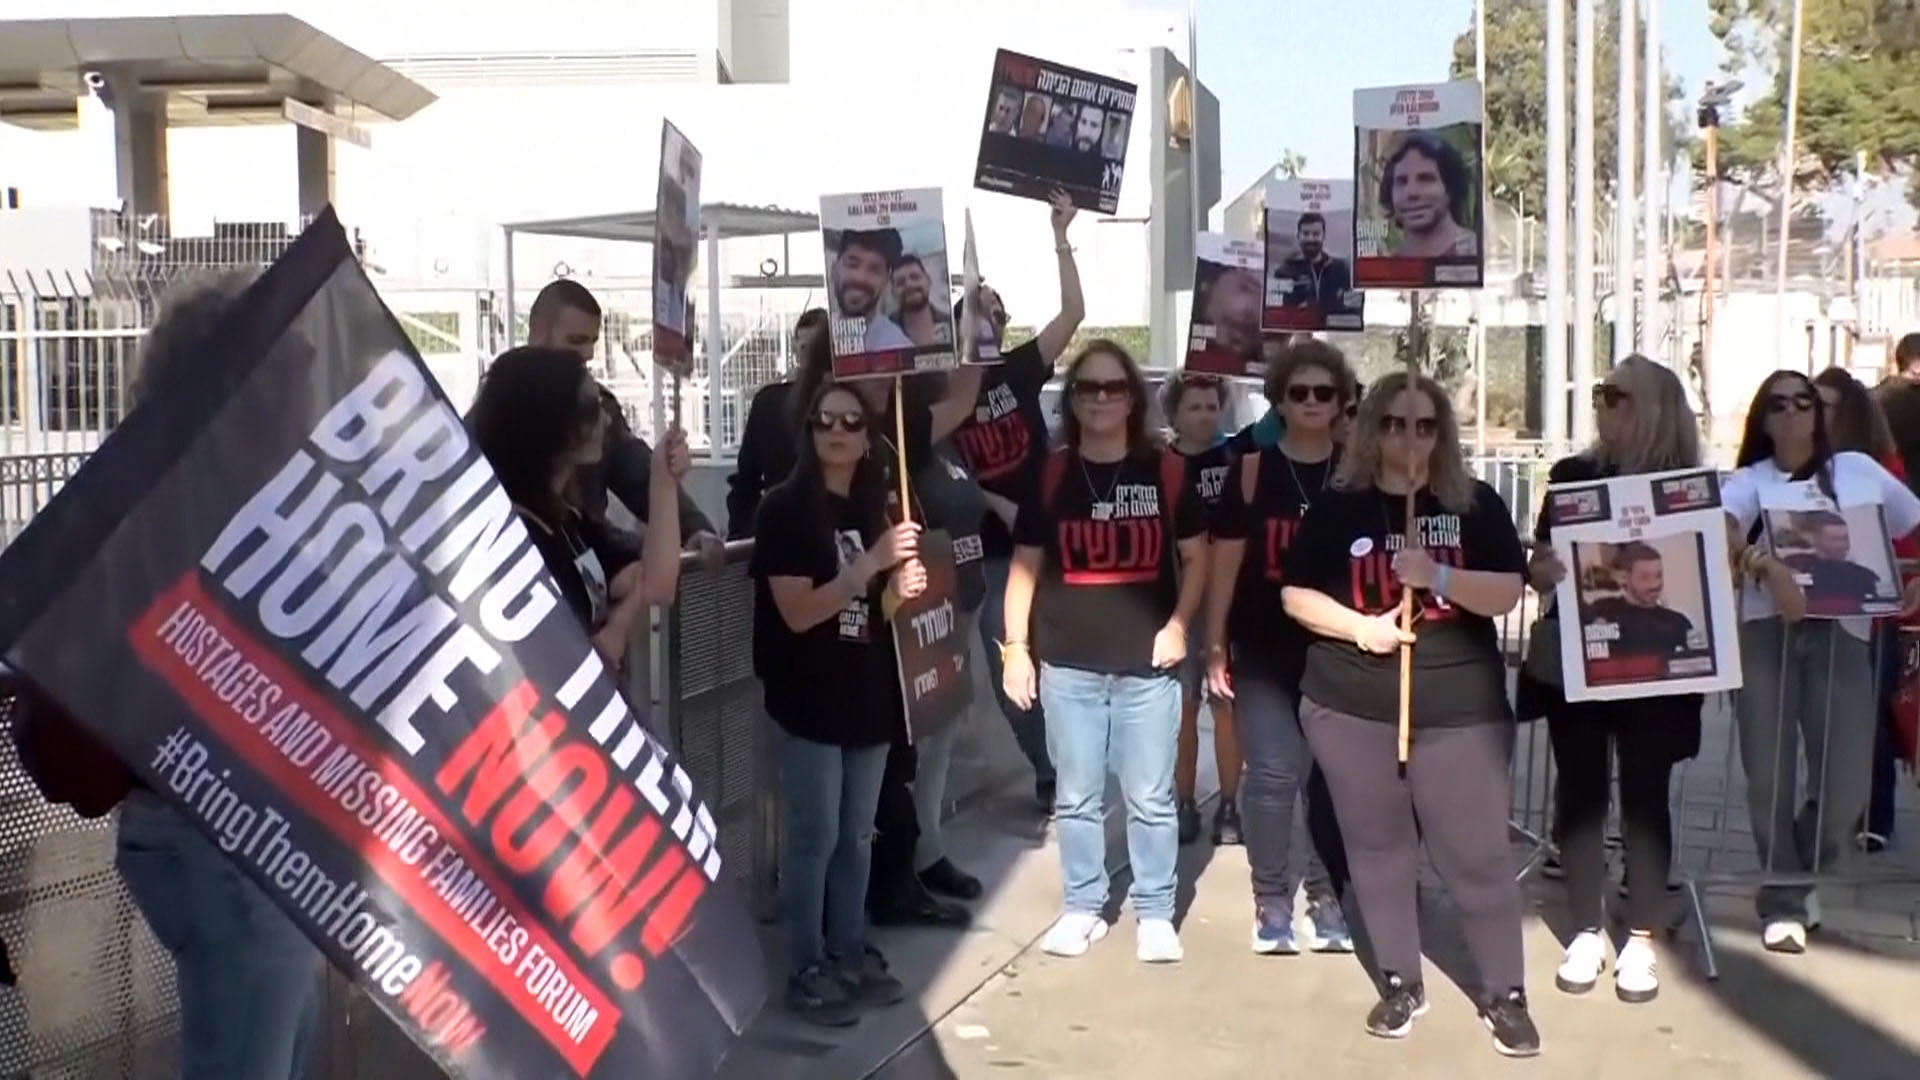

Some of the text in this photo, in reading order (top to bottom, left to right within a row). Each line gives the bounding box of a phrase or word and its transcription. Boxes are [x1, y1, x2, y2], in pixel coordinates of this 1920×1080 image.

[309, 348, 557, 642] BRING
[1059, 519, 1162, 570] עכשיו
[156, 601, 599, 1043] HOSTAGES AND MISSING FAMILIES FORUM
[200, 448, 707, 991] HOME NOW!
[151, 726, 488, 1055] #BringThemHomeNow
